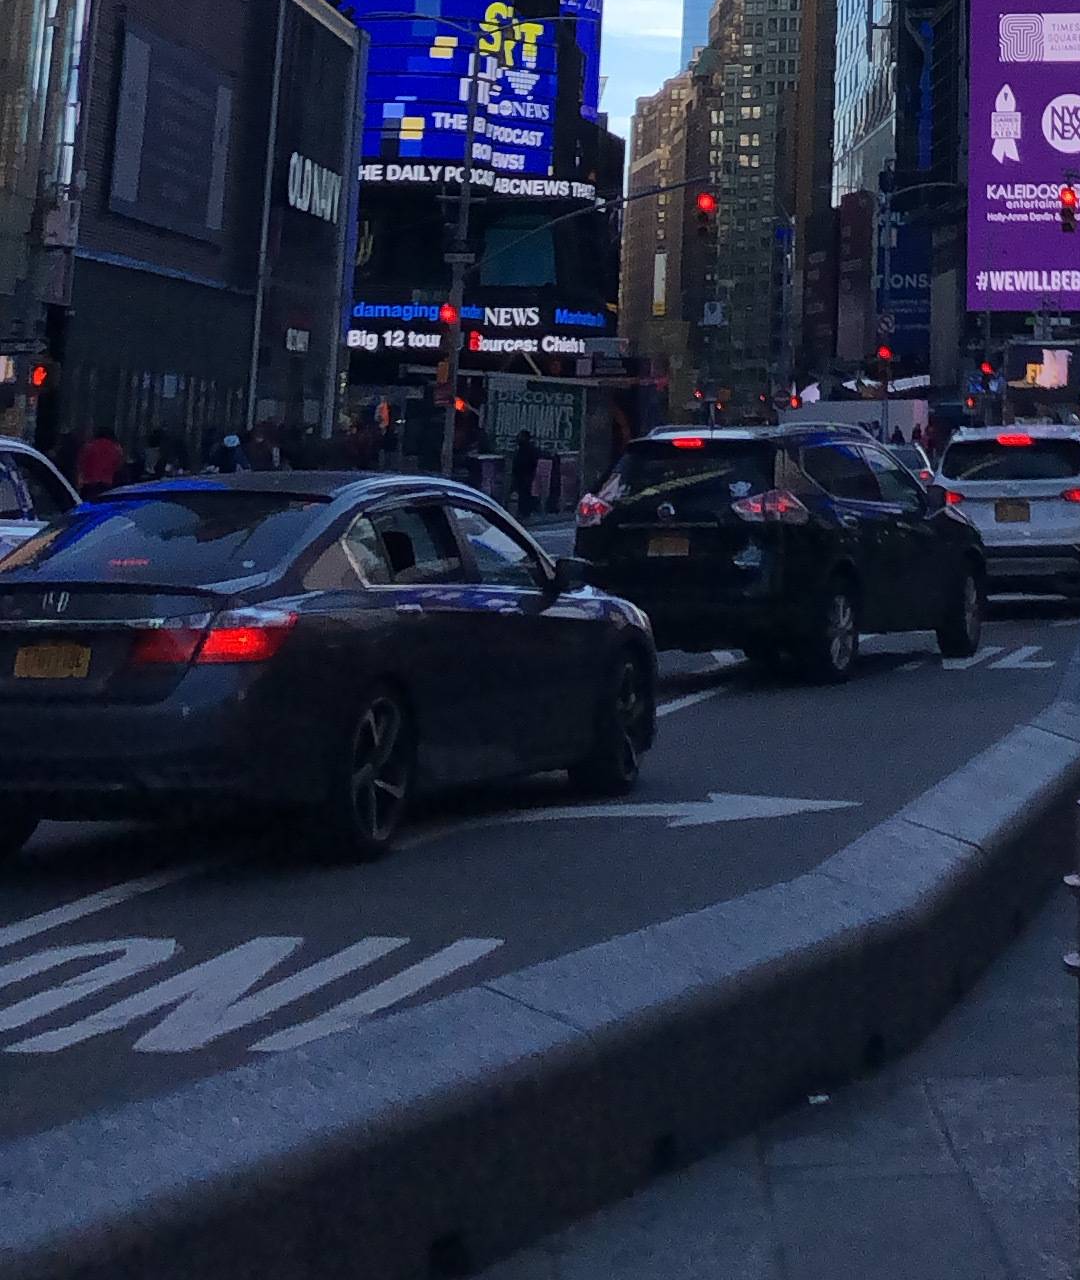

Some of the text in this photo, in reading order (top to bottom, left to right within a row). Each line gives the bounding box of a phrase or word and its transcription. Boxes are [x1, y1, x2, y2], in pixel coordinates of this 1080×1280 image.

[1050, 23, 1080, 33] TIMES
[431, 111, 468, 131] THE
[358, 164, 384, 181] HE
[385, 164, 443, 182] DAILY
[353, 302, 439, 322] damaging
[483, 306, 540, 327] NEWS
[347, 329, 379, 351] Big
[382, 329, 405, 347] 12
